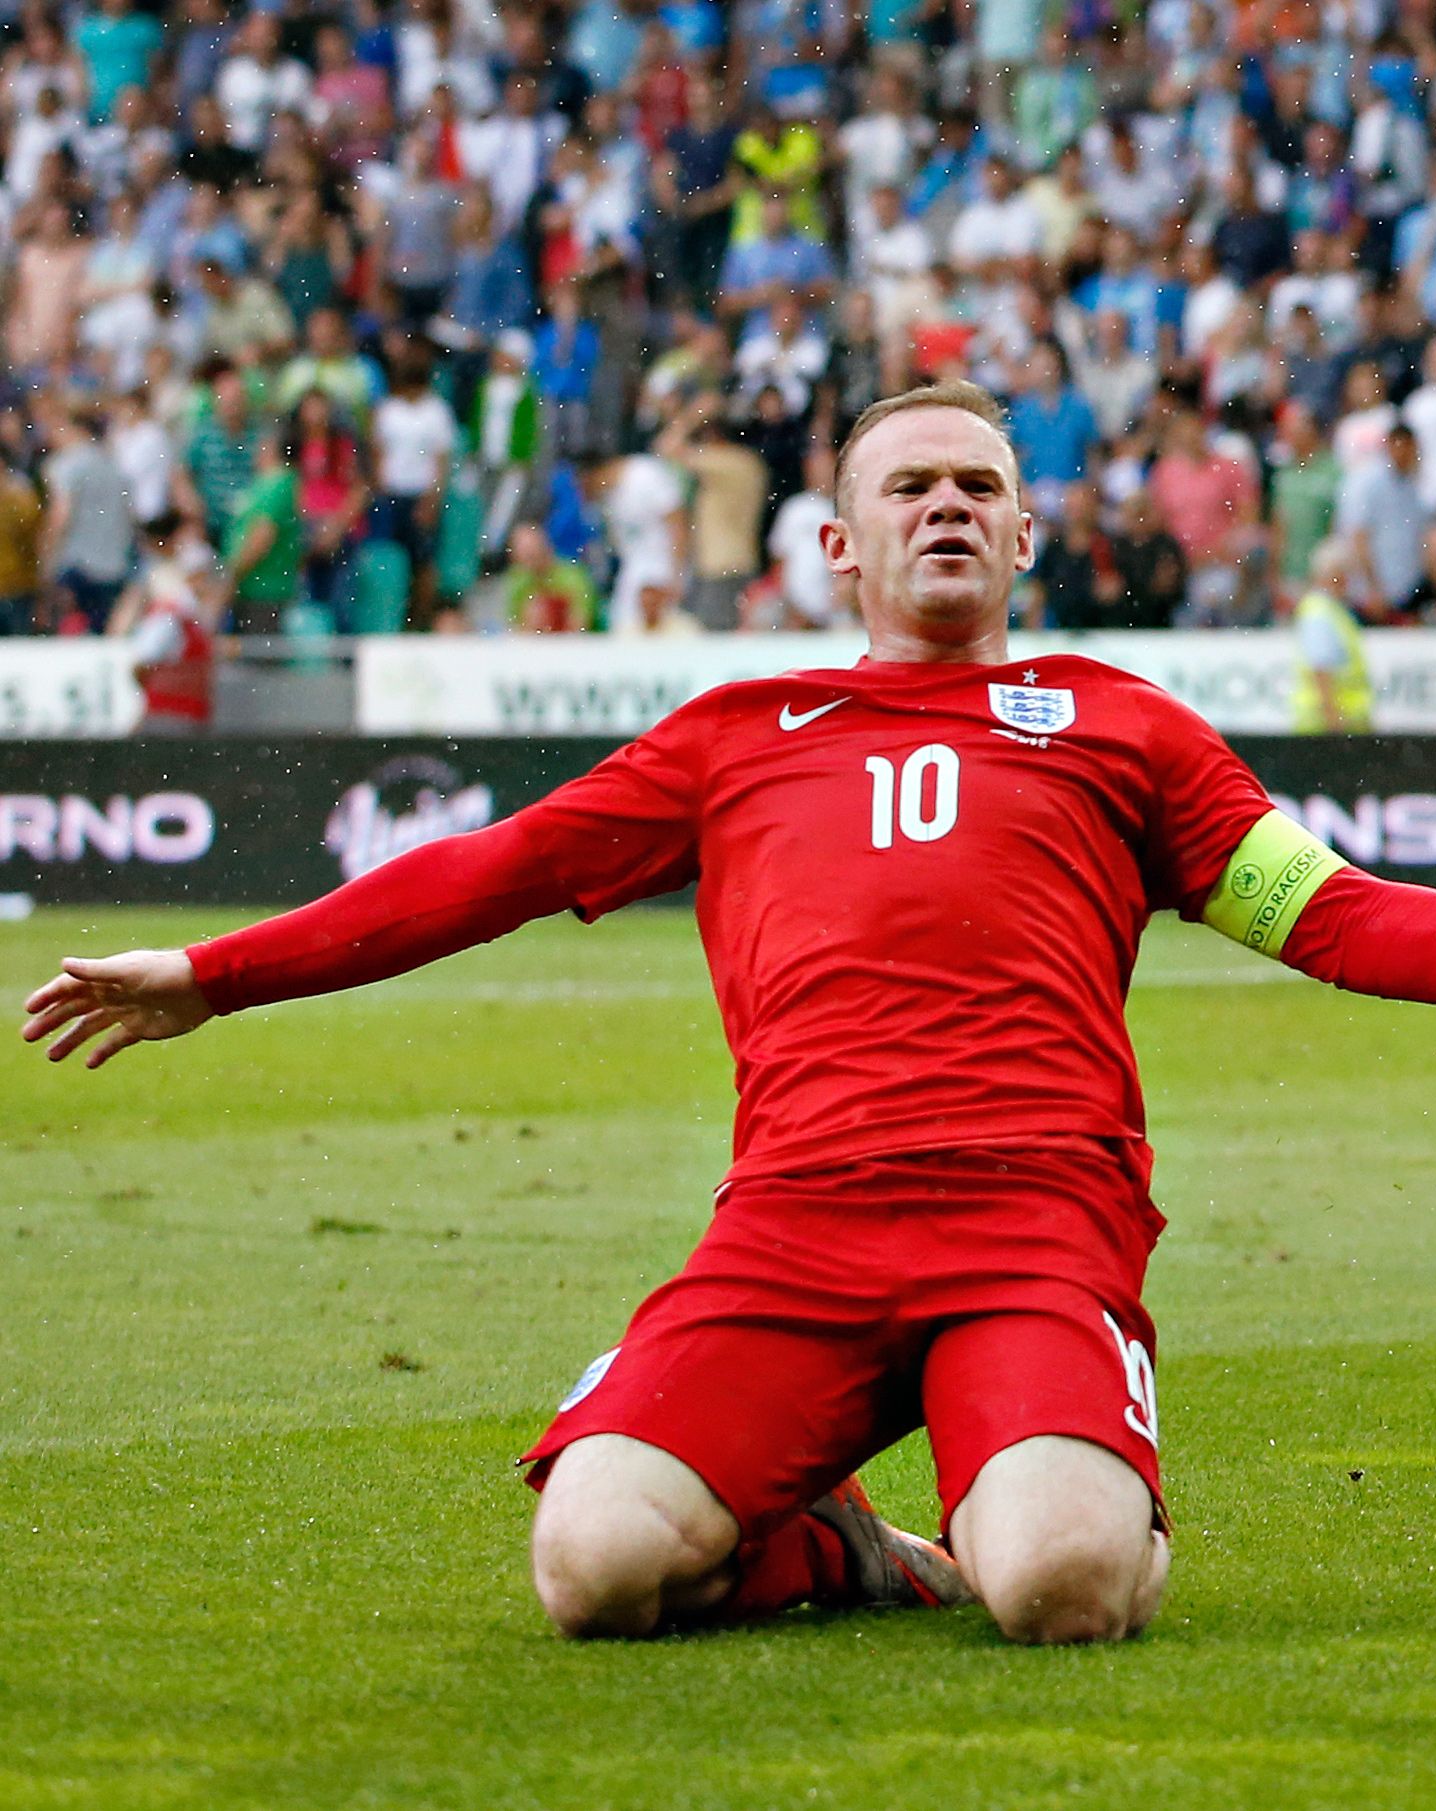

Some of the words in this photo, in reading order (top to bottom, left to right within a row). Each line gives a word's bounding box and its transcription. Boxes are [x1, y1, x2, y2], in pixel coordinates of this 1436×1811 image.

[864, 743, 960, 849] 10
[1258, 906, 1276, 927] TO
[1271, 849, 1320, 904] RACISM
